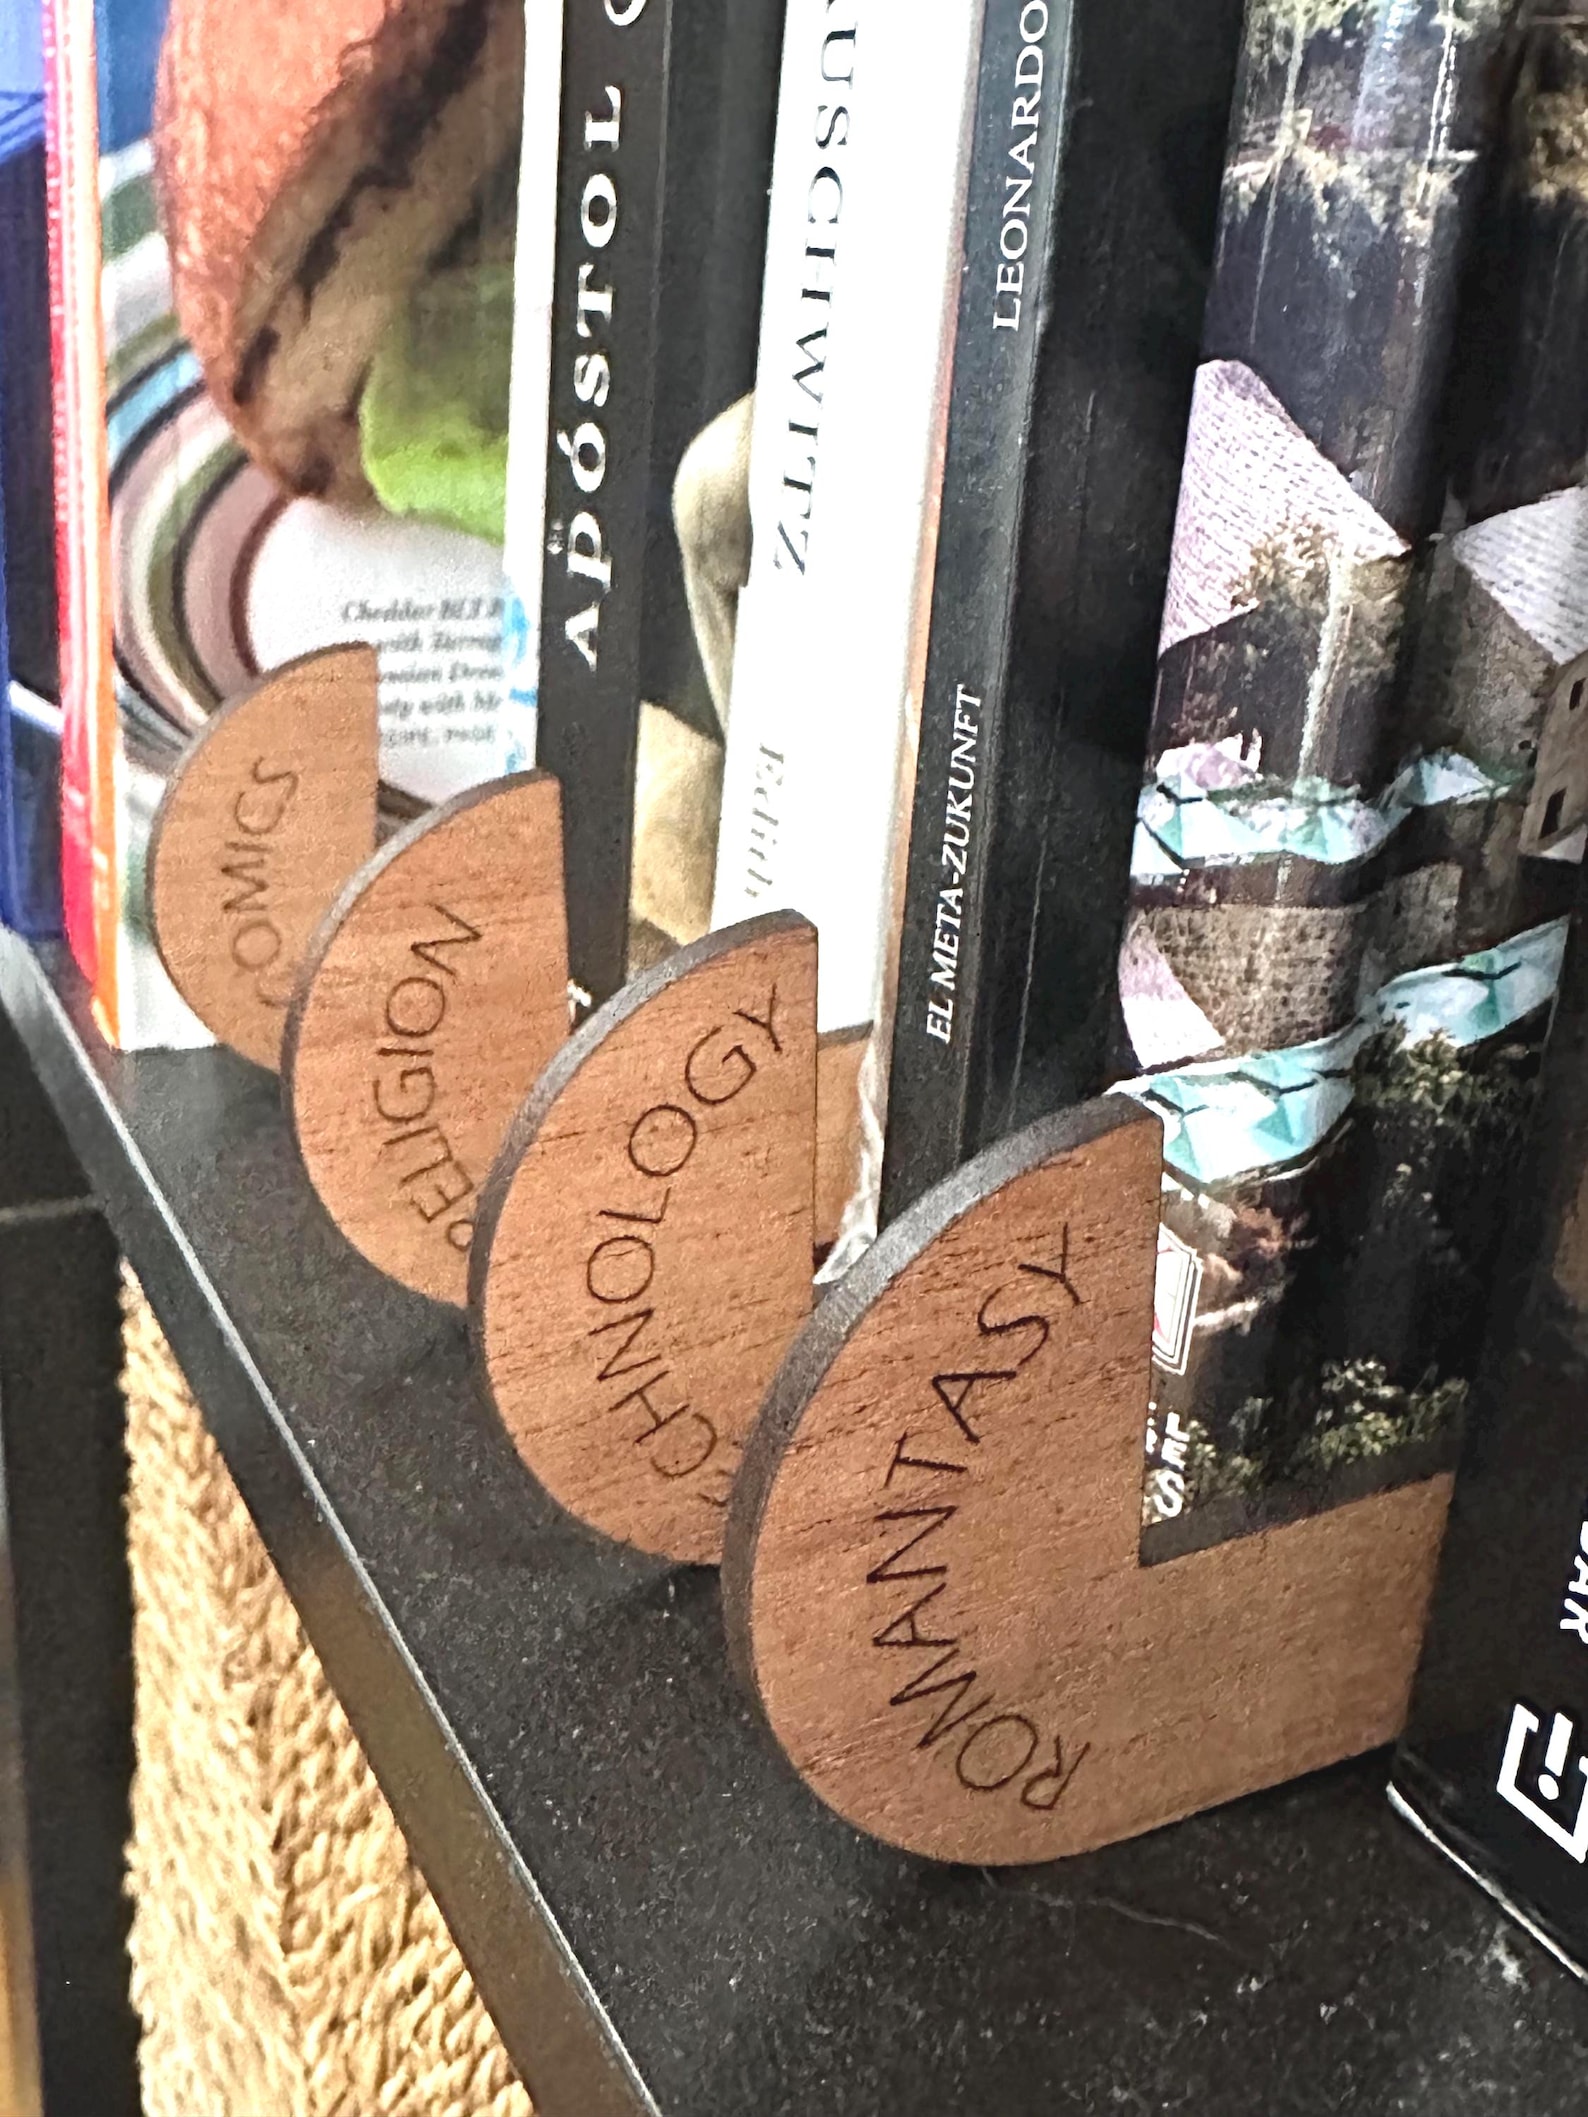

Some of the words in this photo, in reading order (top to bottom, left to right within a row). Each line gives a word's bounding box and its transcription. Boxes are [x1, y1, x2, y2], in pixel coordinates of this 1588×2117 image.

[557, 85, 623, 672] APÓSTOL
[773, 0, 858, 575] USCHWITZ
[992, 0, 1050, 332] LEONARDO
[926, 996, 954, 1044] EL
[930, 683, 982, 991] META-ZUKUNFT
[587, 983, 783, 1508] CHNOLOGY
[865, 1221, 1091, 1811] ROMANTASY
